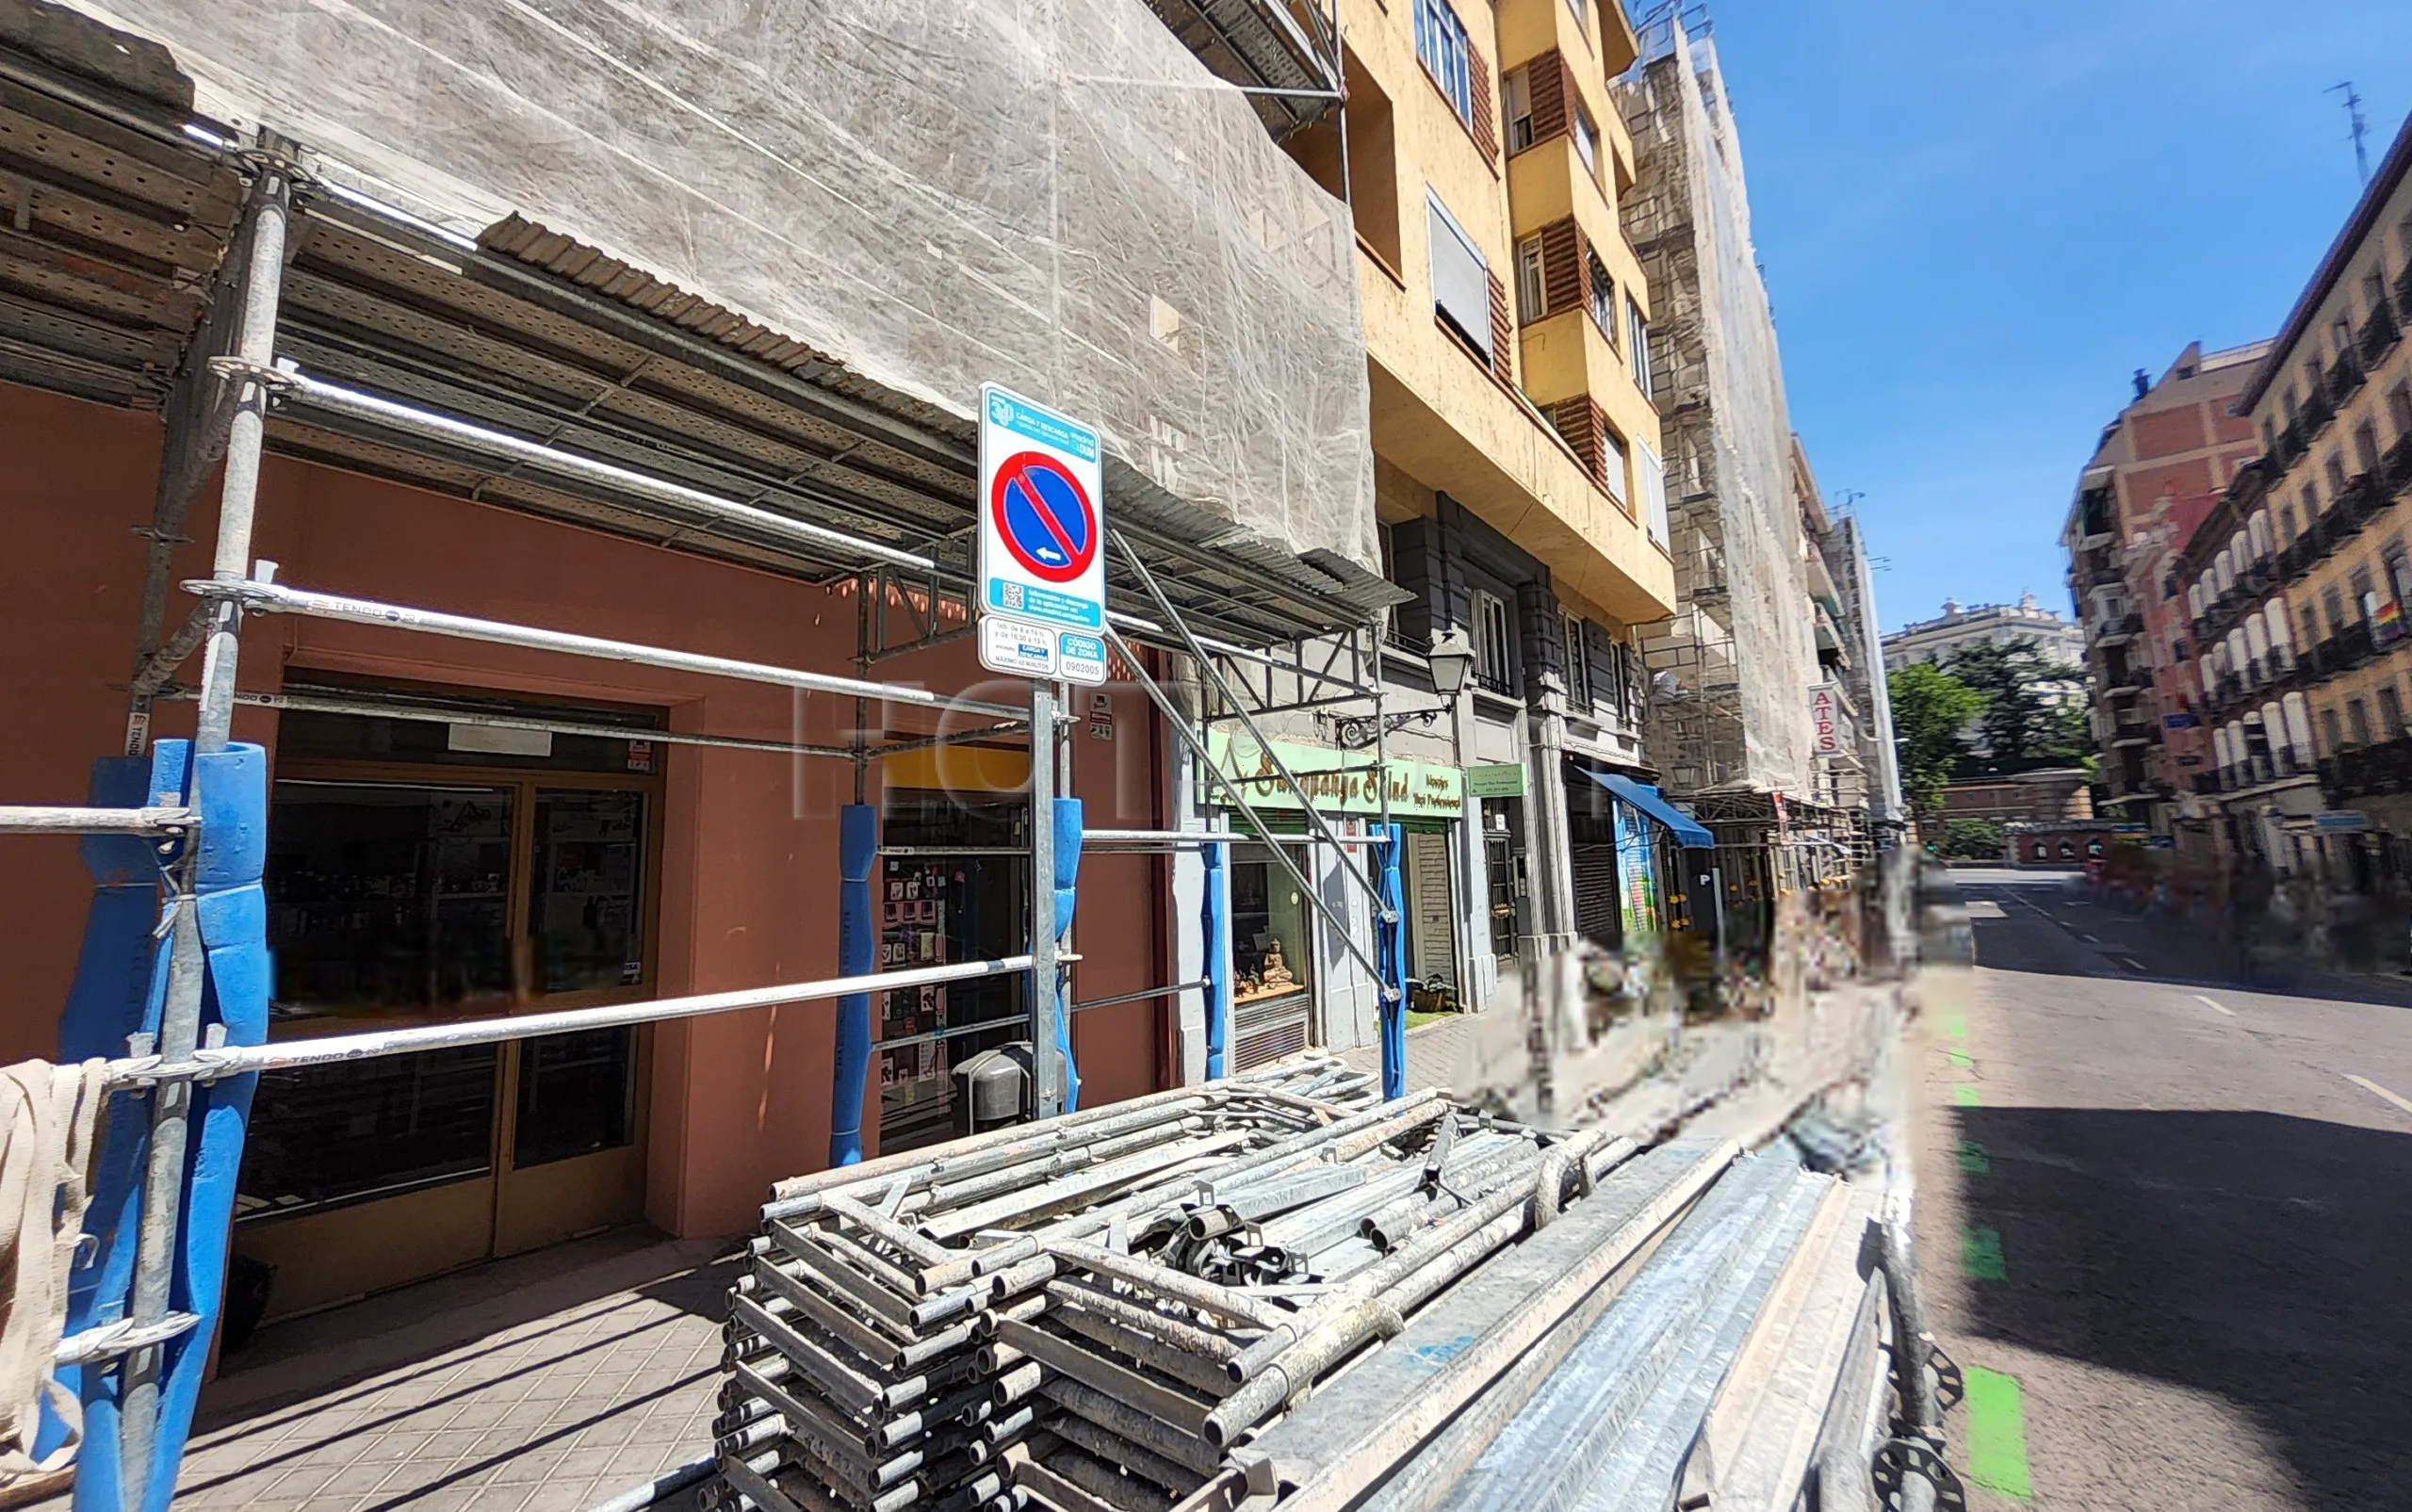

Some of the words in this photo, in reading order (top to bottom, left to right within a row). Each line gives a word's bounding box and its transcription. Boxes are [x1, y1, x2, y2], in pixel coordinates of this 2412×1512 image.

[1067, 636, 1097, 650] CÓDIGO
[1066, 646, 1077, 655] DE
[1078, 648, 1099, 659] ZONA
[1066, 661, 1100, 675] 0902005
[1814, 691, 1836, 750] ATES
[1363, 767, 1409, 805] Slud
[1700, 874, 1711, 886] P
[291, 1052, 345, 1064] TENDO
